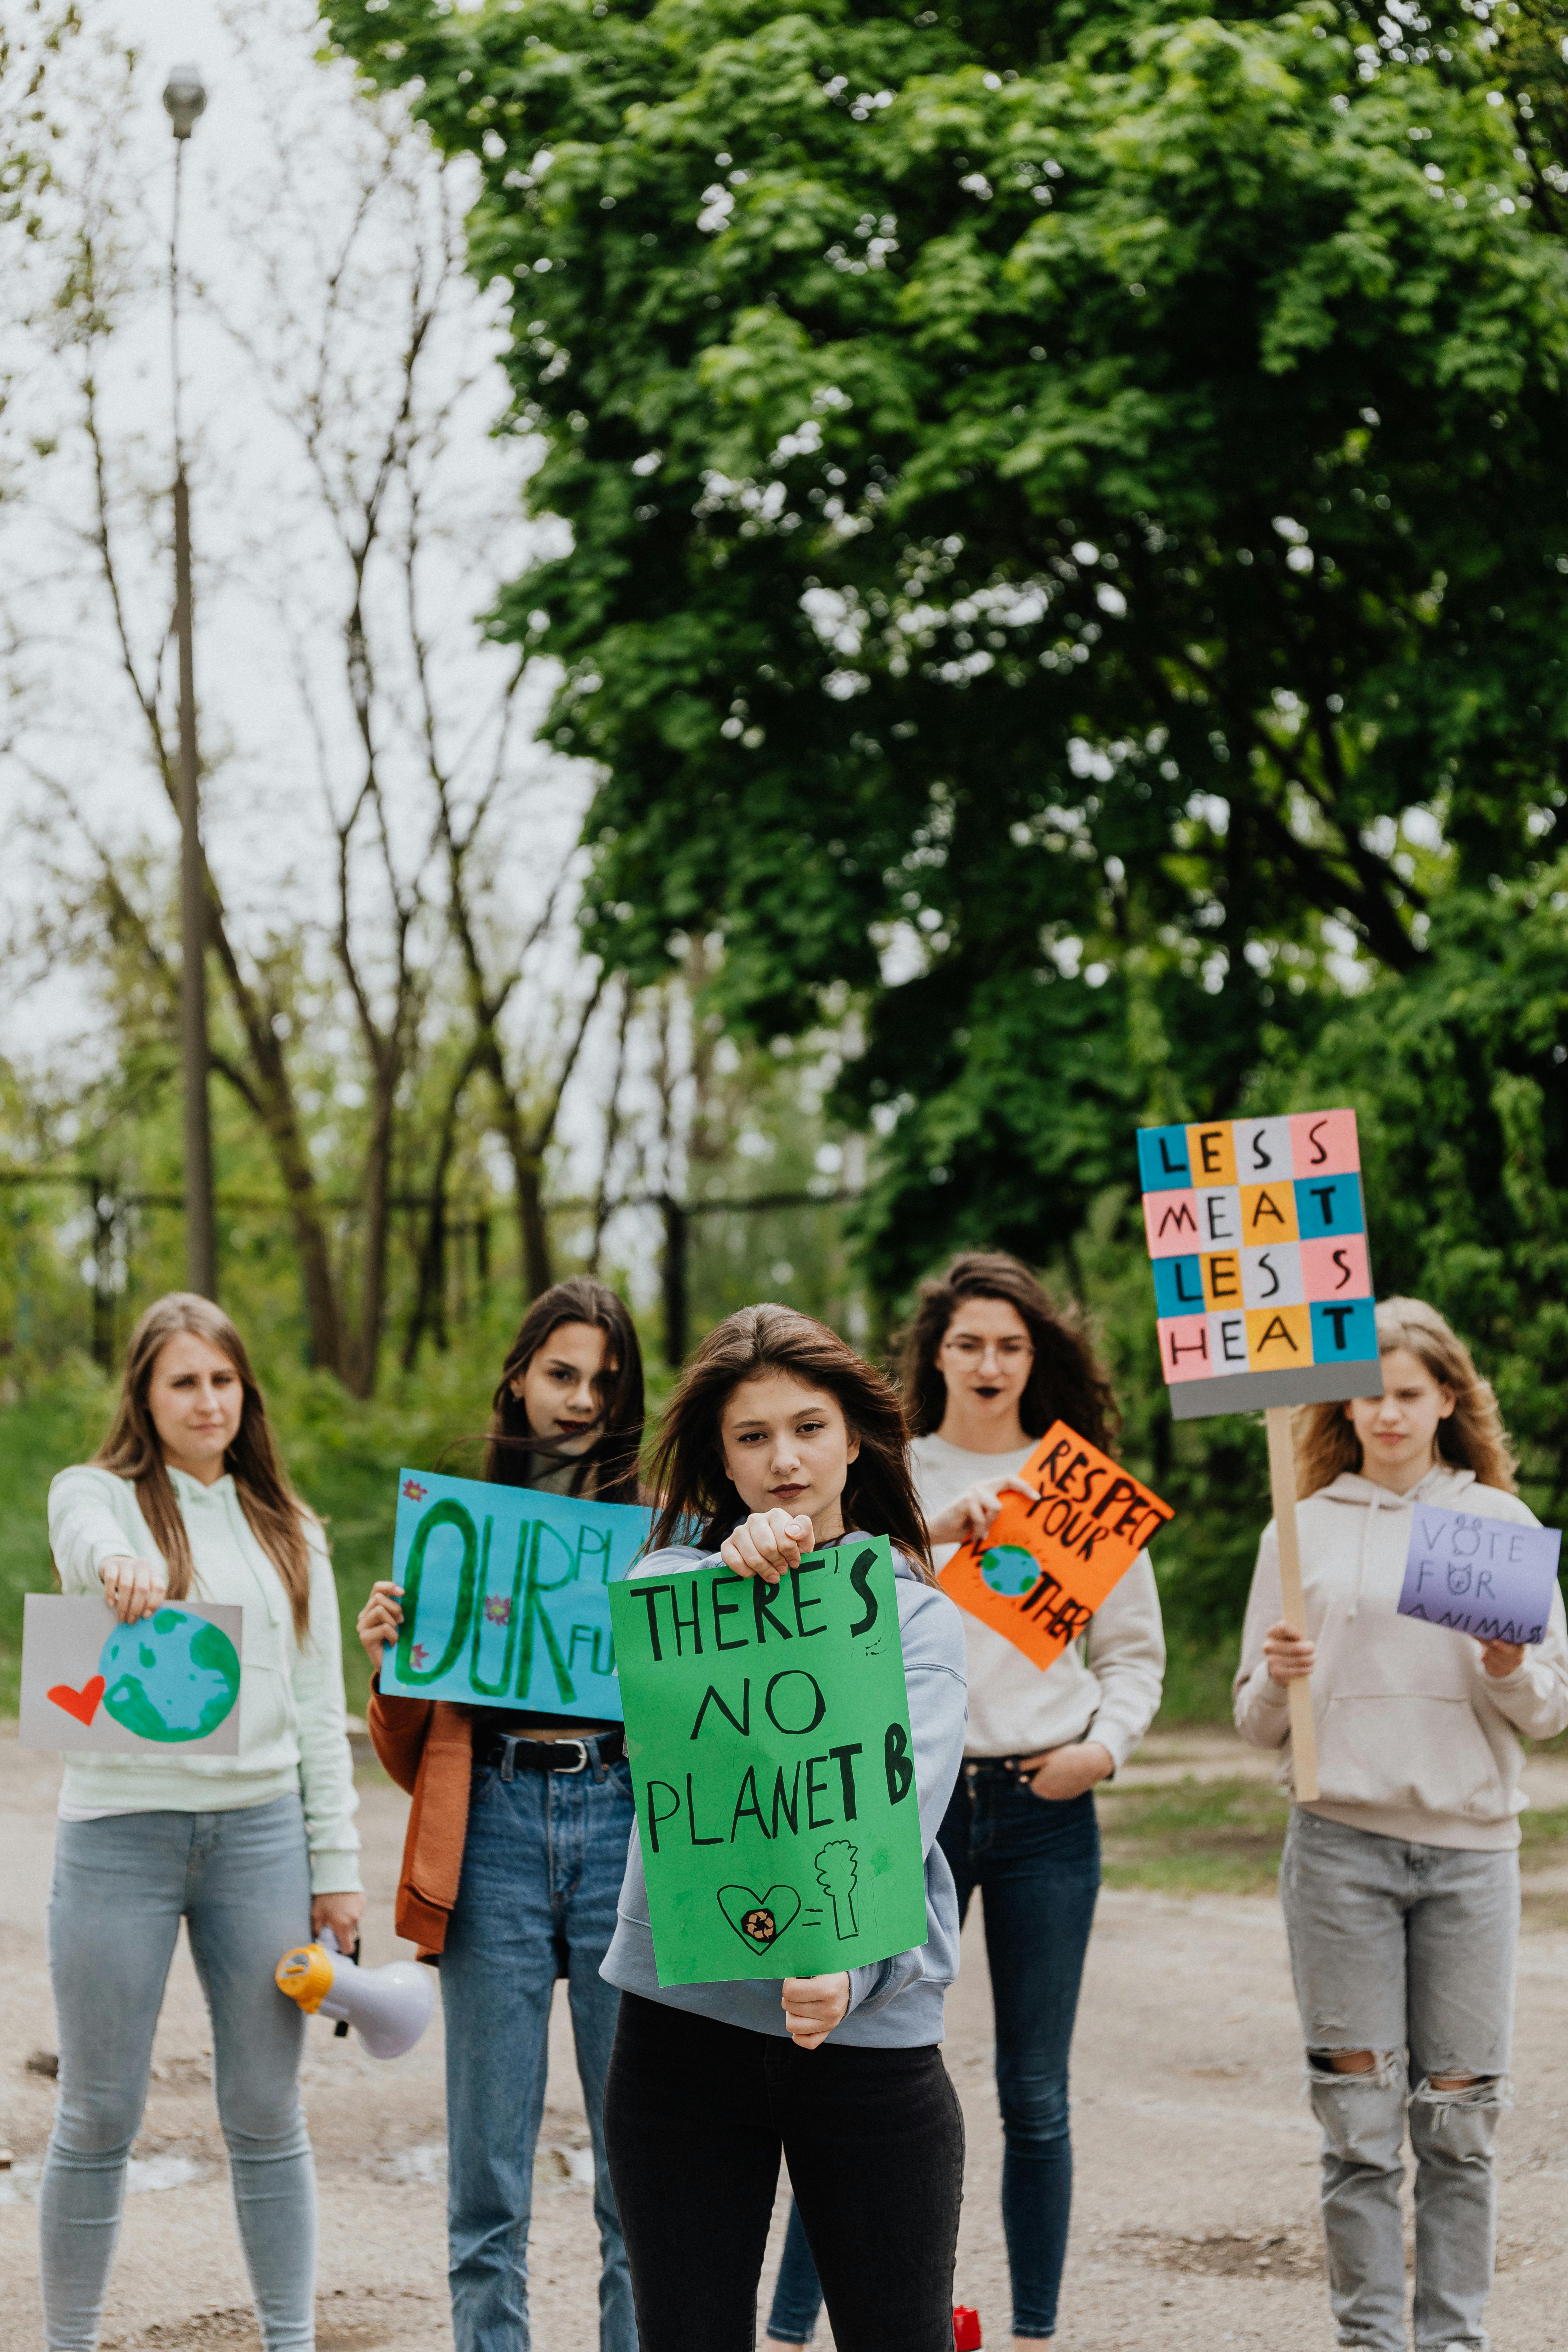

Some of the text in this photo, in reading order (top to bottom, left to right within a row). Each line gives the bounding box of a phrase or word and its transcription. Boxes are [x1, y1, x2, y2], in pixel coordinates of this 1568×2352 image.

[1160, 1120, 1328, 1173] LESS
[1159, 1186, 1336, 1241] MEAT
[1175, 1249, 1352, 1302] LESS
[1171, 1306, 1354, 1366] HEAT
[1027, 1482, 1109, 1562] YOUR
[1421, 1514, 1525, 1563] VOTE
[395, 1498, 613, 1704] OUR PL
[629, 1548, 878, 1661] THERE'S
[1416, 1560, 1496, 1600] FOR
[567, 1624, 617, 1676] FU
[690, 1670, 826, 1739] NO
[647, 1722, 914, 1853] PLANET B
